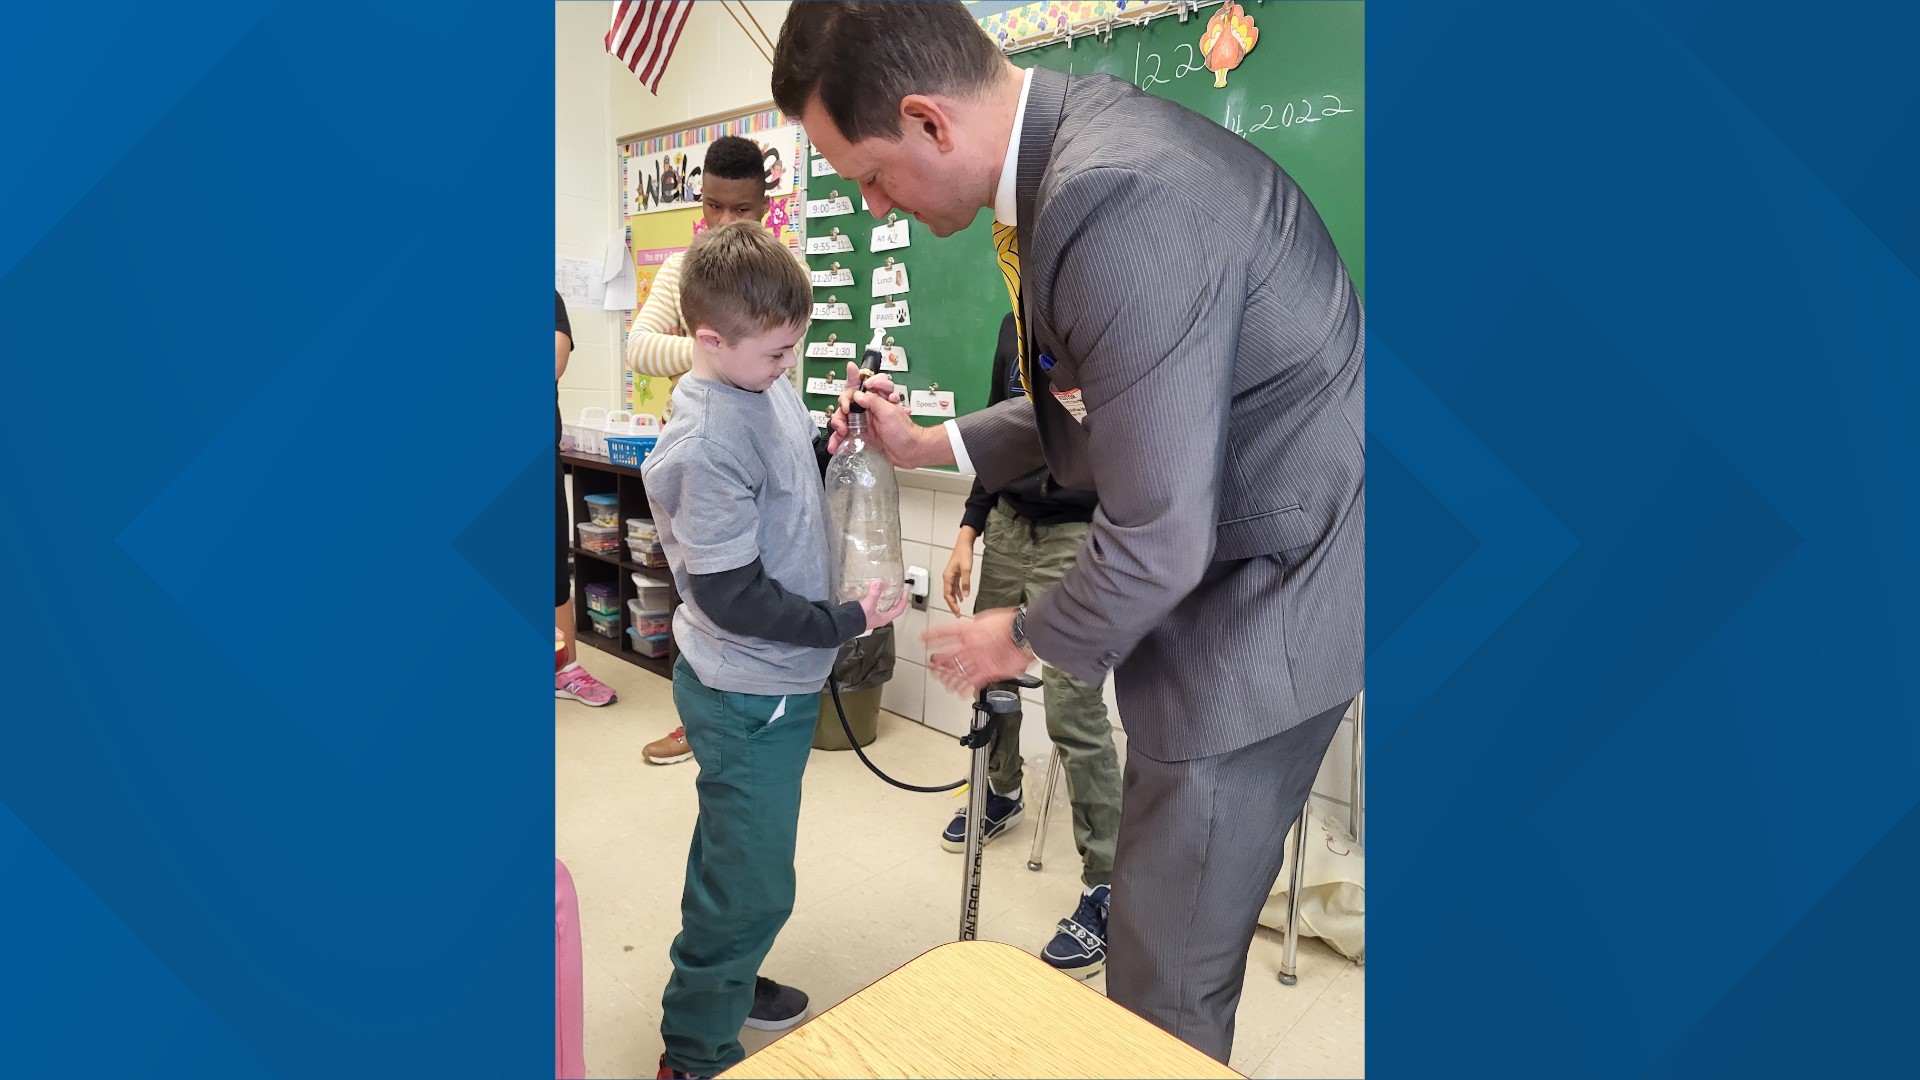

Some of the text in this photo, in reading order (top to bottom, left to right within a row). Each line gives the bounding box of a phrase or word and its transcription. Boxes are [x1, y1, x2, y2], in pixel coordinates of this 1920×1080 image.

[636, 147, 781, 211] Welce
[877, 276, 894, 285] Lunch
[876, 313, 894, 321] PAWS
[916, 400, 938, 408] Speech
